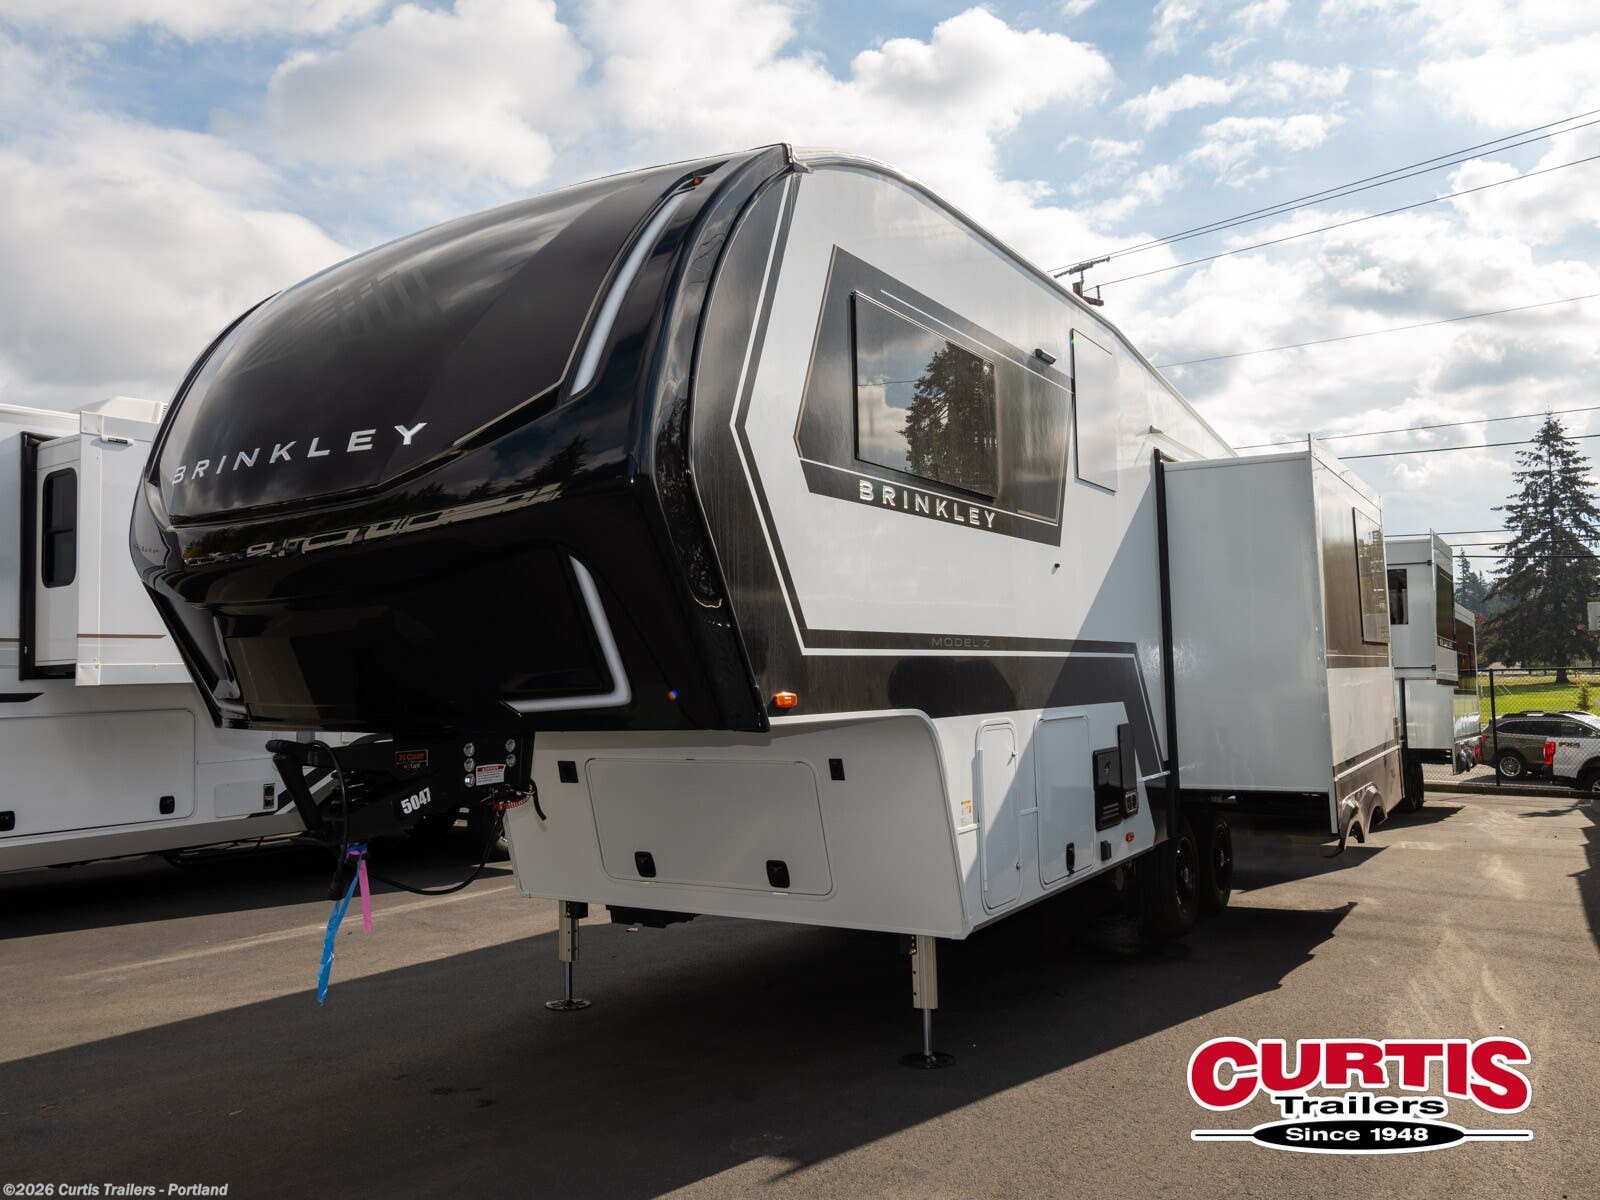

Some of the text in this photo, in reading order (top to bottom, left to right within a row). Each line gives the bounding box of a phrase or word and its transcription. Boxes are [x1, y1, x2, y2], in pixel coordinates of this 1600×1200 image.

[172, 422, 428, 485] BRINKLEY
[859, 479, 995, 528] BRINKLEY
[931, 637, 979, 648] MODEL
[400, 787, 431, 814] 5047
